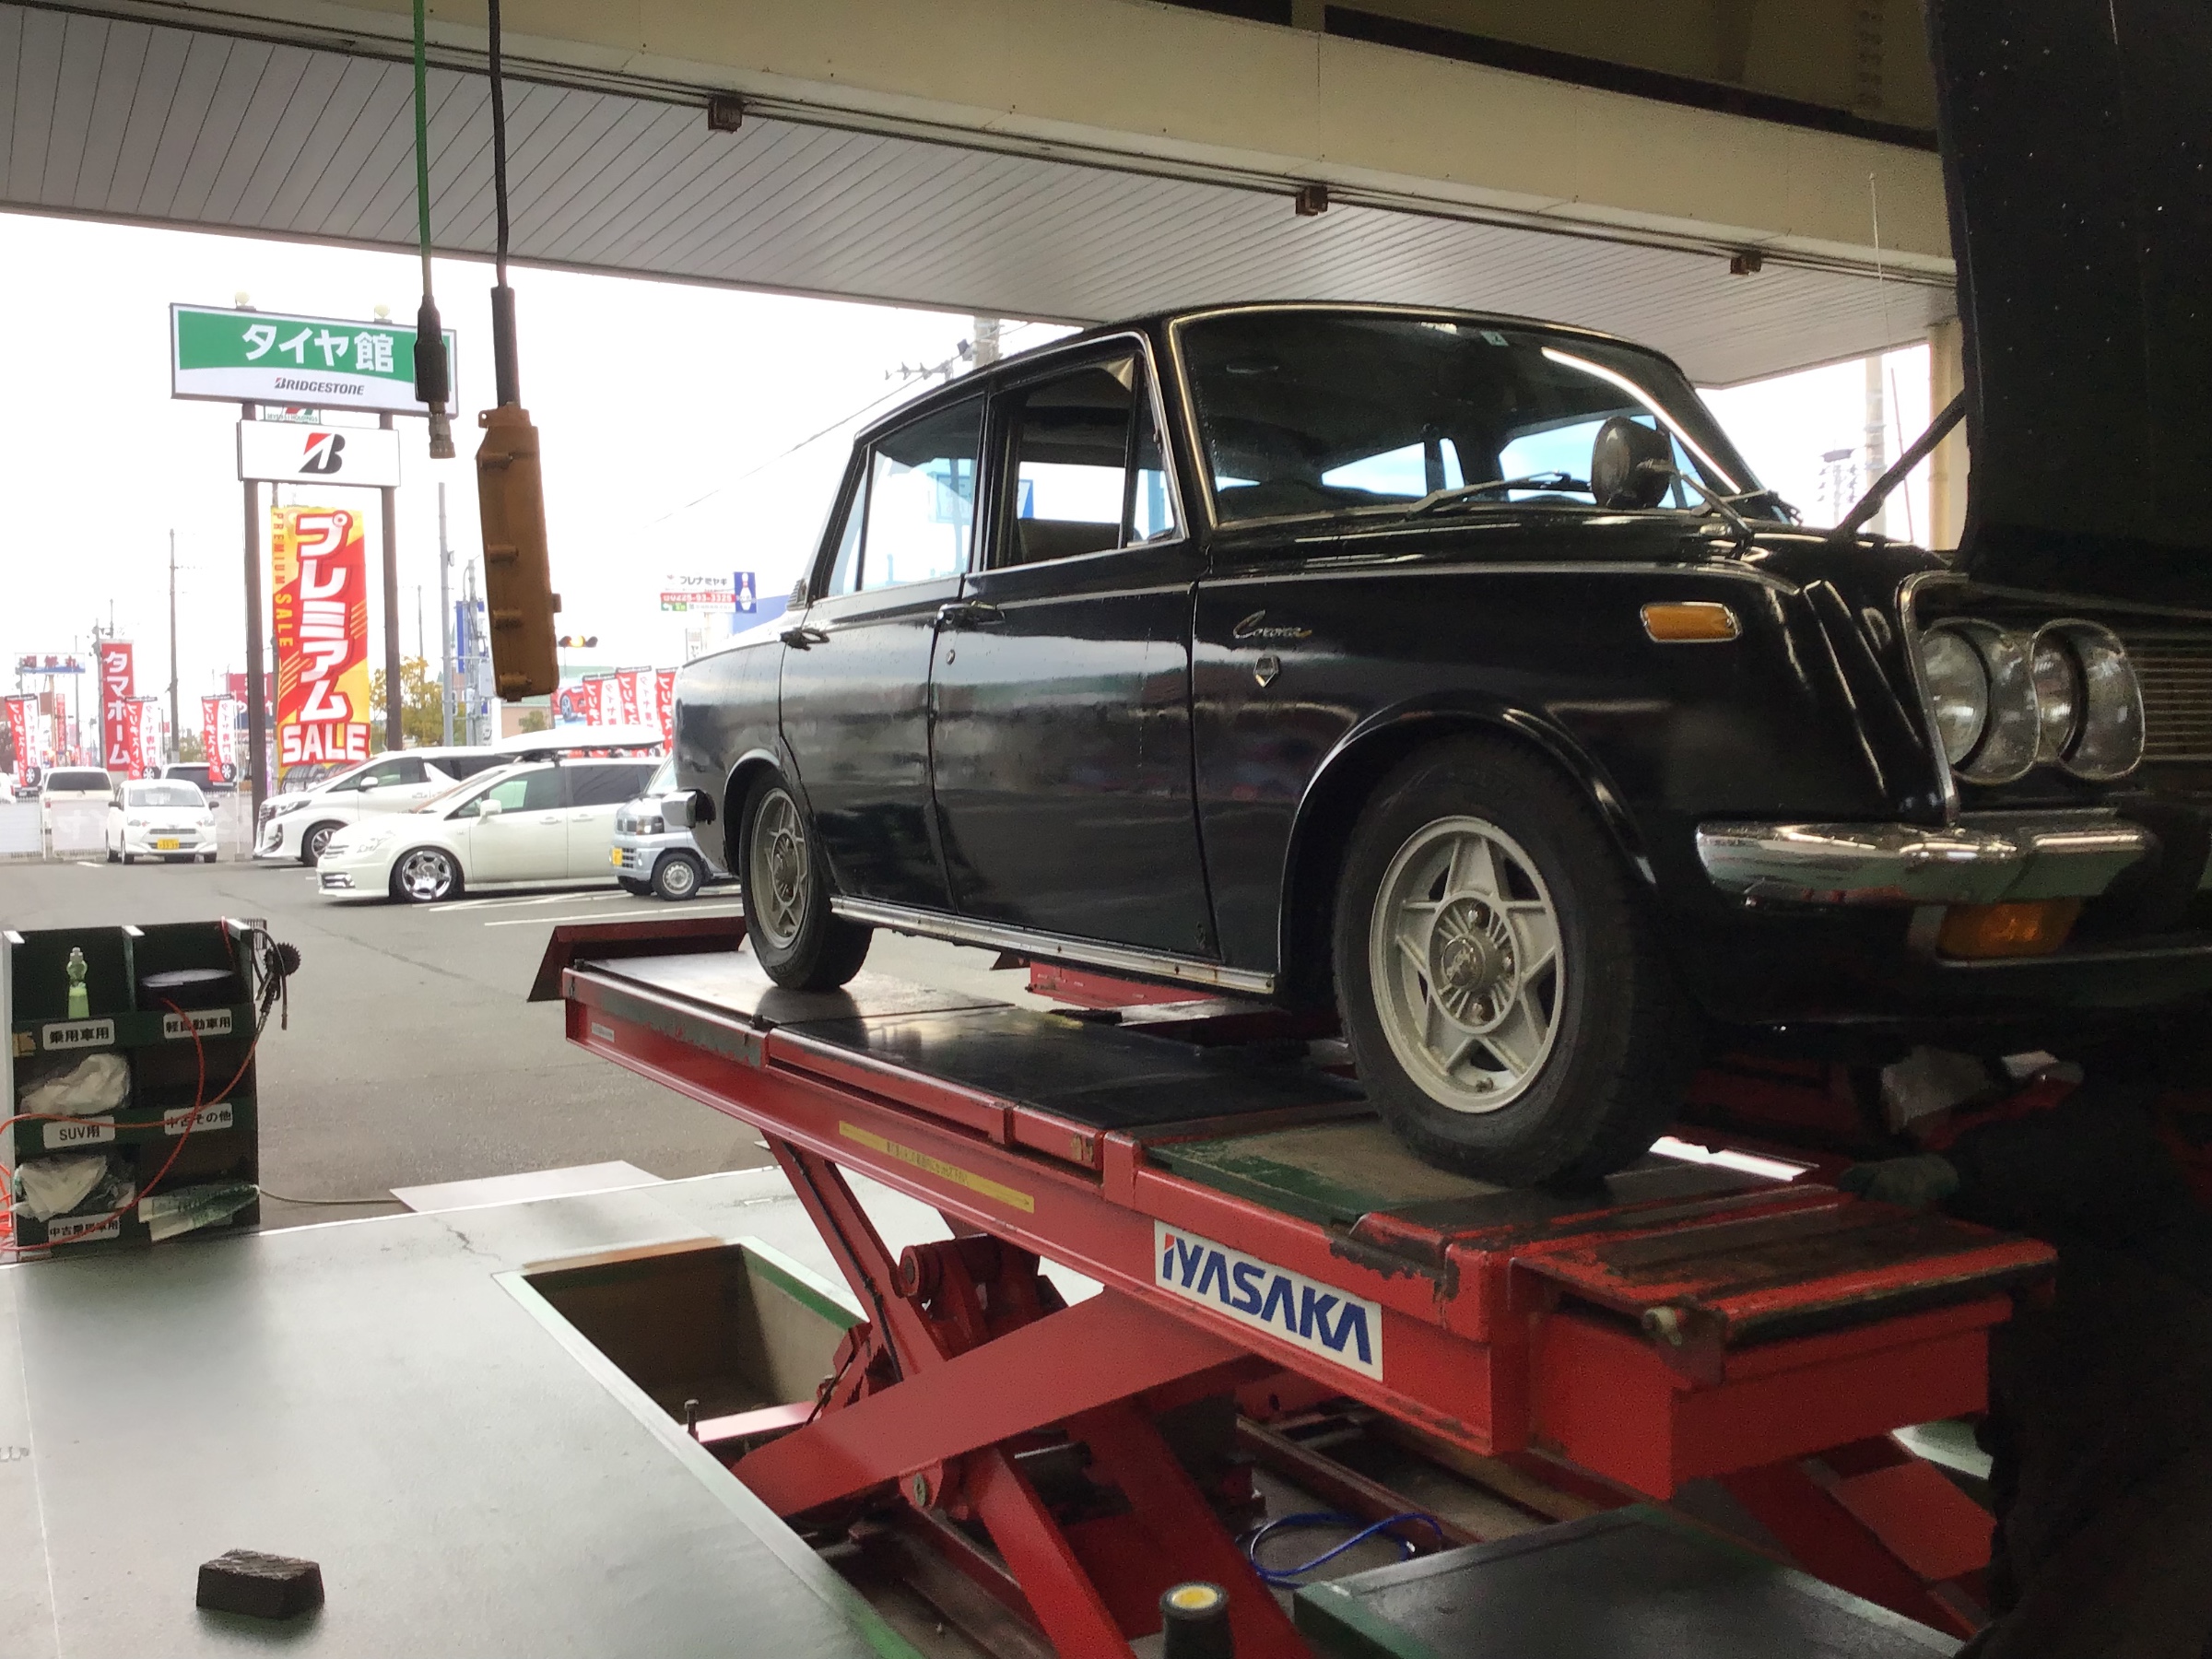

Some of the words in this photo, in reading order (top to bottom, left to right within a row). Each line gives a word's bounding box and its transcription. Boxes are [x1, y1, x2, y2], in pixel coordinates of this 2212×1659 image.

[241, 324, 394, 373] タイヤ館
[275, 377, 365, 396] BRIDGESTONE
[273, 512, 286, 584] PREMIUM
[276, 593, 293, 647] SALE
[298, 512, 350, 723] プレミアム
[103, 651, 131, 766] タマホーム
[282, 724, 367, 764] SALE
[49, 1026, 110, 1044] 乗用車用
[59, 1124, 100, 1141] SUV用
[1162, 1232, 1373, 1365] IYASAKA
